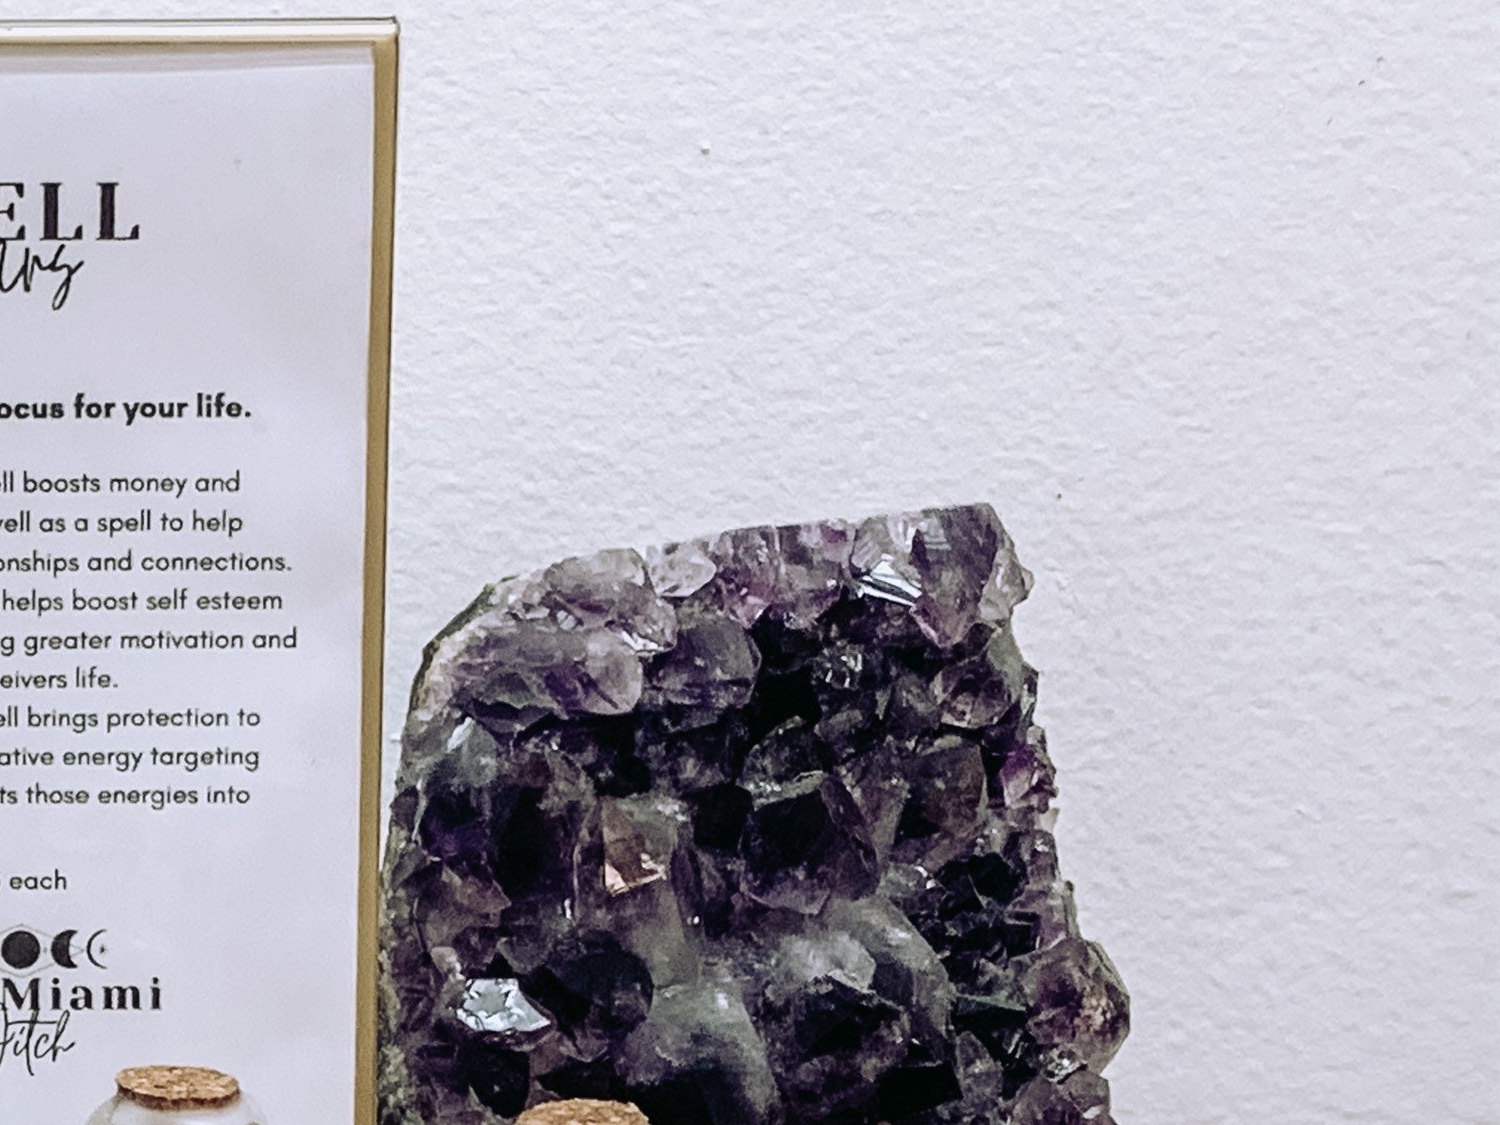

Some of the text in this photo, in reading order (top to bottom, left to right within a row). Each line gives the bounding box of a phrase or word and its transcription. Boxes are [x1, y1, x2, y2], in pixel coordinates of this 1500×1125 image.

[73, 392, 116, 419] for
[122, 402, 189, 426] your
[197, 392, 251, 418] life.
[23, 470, 101, 493] boosts
[110, 477, 187, 499] money
[195, 469, 240, 492] and
[39, 518, 66, 533] as
[74, 518, 88, 532] a
[97, 509, 151, 538] spell
[160, 513, 183, 532] to
[192, 509, 243, 538] help
[87, 548, 132, 571] and
[141, 553, 292, 571] connections.
[2, 588, 63, 617] helps
[72, 588, 138, 611] boost
[146, 588, 188, 610] self
[196, 592, 282, 610] esteem
[24, 632, 112, 657] greater
[120, 630, 244, 649] motivation
[252, 626, 297, 649] and
[76, 666, 118, 688] life.
[28, 705, 98, 734] brings
[107, 708, 229, 733] protection
[237, 708, 261, 726] to
[63, 752, 143, 772] energy
[150, 747, 259, 772] targeting
[25, 782, 90, 804] those
[98, 786, 198, 810] energies
[207, 786, 250, 804] into
[9, 868, 67, 890] each
